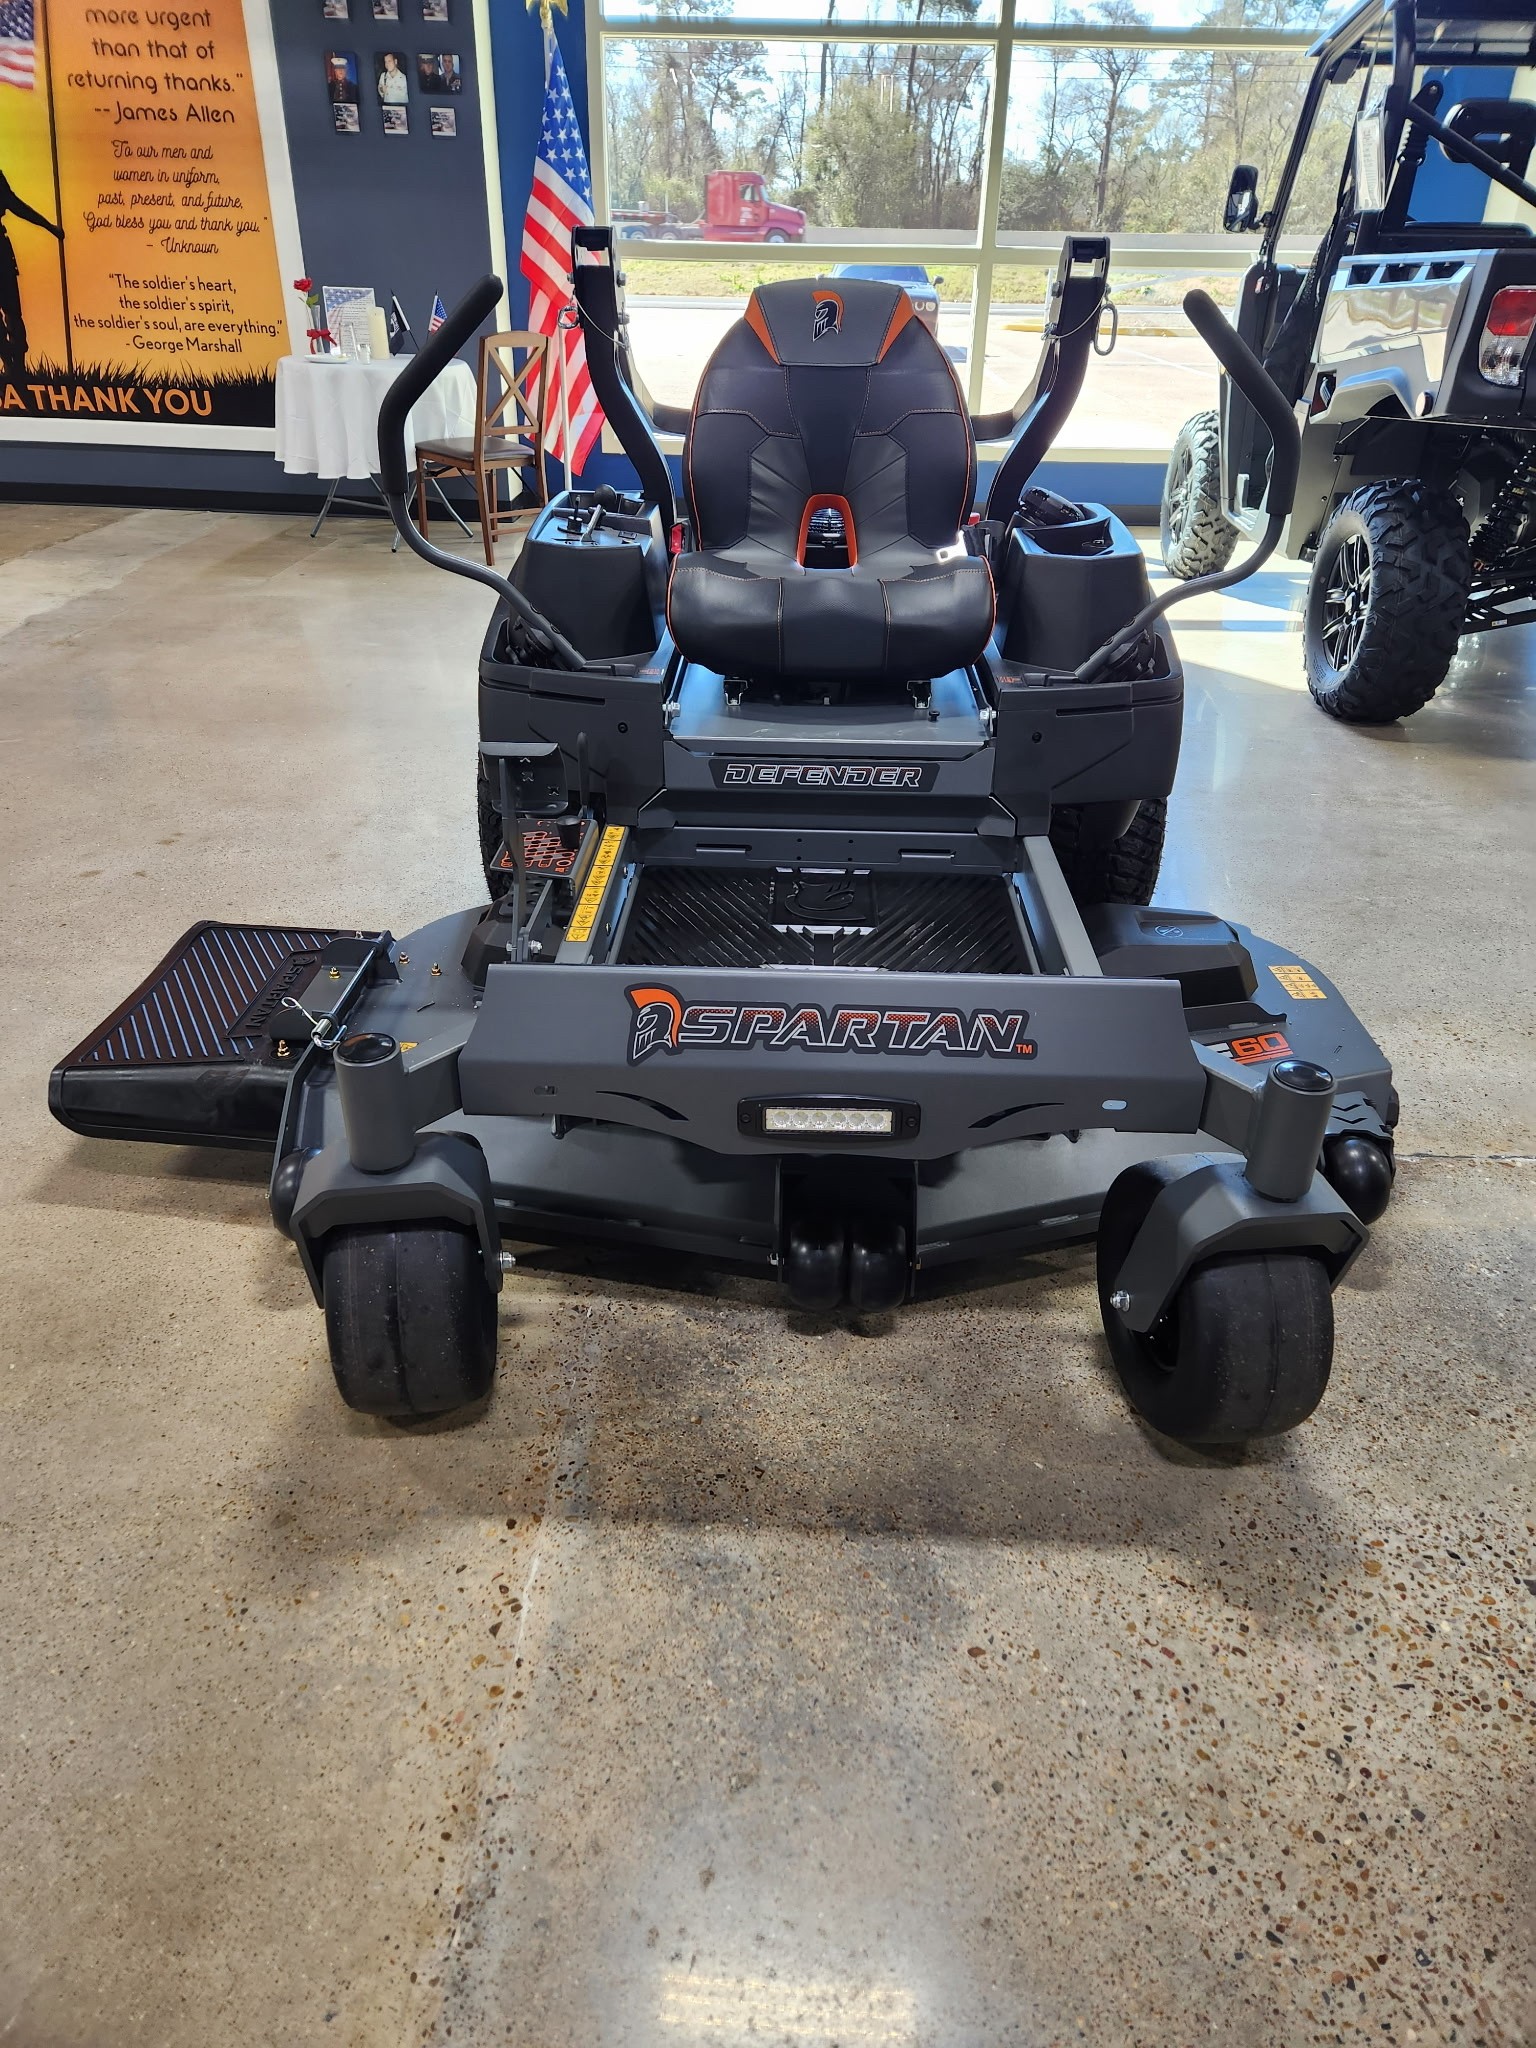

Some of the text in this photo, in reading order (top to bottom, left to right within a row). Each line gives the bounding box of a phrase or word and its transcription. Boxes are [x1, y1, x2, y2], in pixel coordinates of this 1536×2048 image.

[85, 8, 211, 31] more urgent
[92, 37, 215, 60] than that of
[67, 69, 244, 95] returning thanks."
[186, 102, 235, 123] Allen
[136, 145, 159, 158] our
[161, 147, 187, 159] men
[190, 145, 214, 160] and
[113, 169, 154, 182] women
[157, 168, 170, 182] in
[181, 193, 204, 207] and
[83, 211, 113, 233] God
[115, 213, 145, 229] bless
[148, 218, 172, 235] you
[174, 216, 198, 230] and
[200, 216, 233, 231] thank
[160, 236, 219, 254] Unknown
[142, 274, 196, 291] soldier's
[197, 275, 237, 295] heart,
[119, 293, 234, 315] the soldier's spirit,
[73, 312, 283, 338] the soldier's soul, are everything."
[132, 334, 184, 354] George
[185, 336, 243, 353] Marshall
[27, 384, 141, 414] THANK
[143, 388, 213, 417] YOU
[722, 763, 922, 788] DEFENDER
[244, 965, 304, 1028] SPARTAN
[677, 1005, 1024, 1053] SPARTAN
[1231, 1031, 1290, 1057] 60
